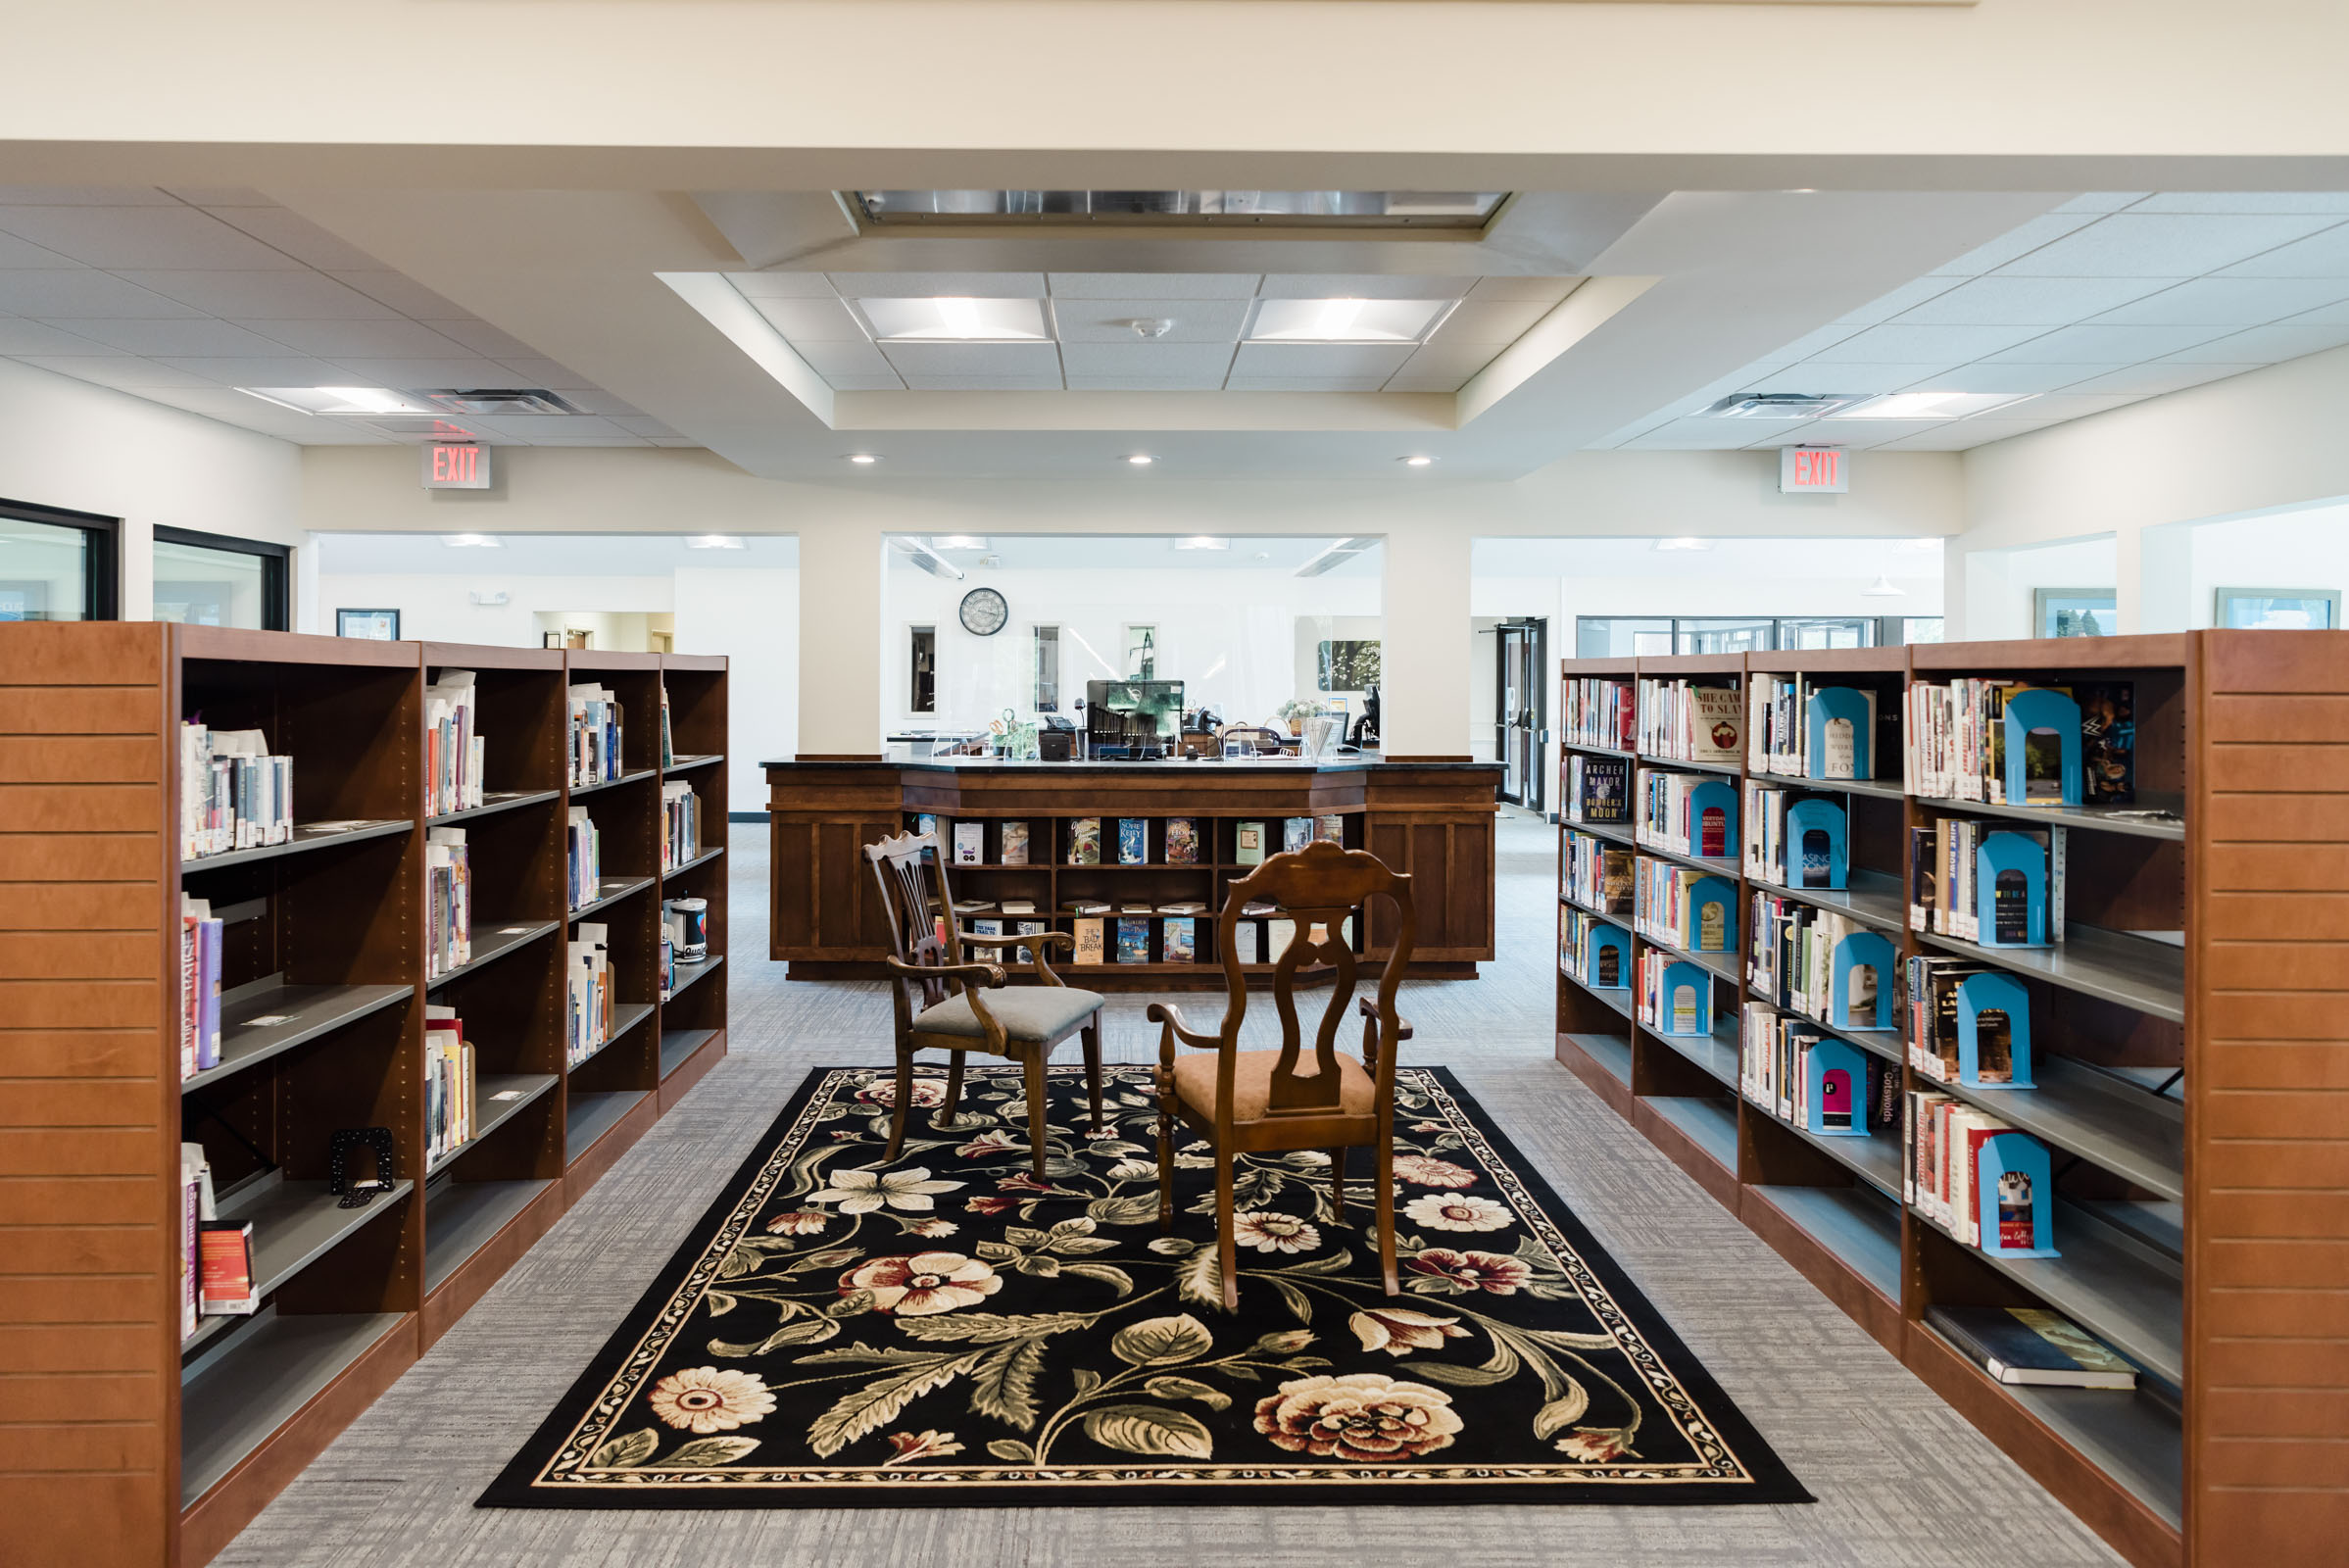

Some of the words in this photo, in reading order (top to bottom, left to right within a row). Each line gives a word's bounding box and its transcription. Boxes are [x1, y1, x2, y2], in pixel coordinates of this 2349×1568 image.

[433, 447, 479, 482] EXIT
[1795, 452, 1841, 486] EXIT
[1719, 692, 1741, 704] CAM
[1700, 704, 1714, 714] TO
[1586, 764, 1624, 775] ARCHER
[1589, 776, 1620, 786] MAYOR
[1590, 808, 1617, 818] MOON
[1120, 828, 1142, 839] KELLY
[1802, 854, 1831, 863] ASING
[1083, 935, 1098, 944] BAD
[1079, 942, 1103, 953] BREAK
[1884, 1072, 1893, 1122] Cotswolds
